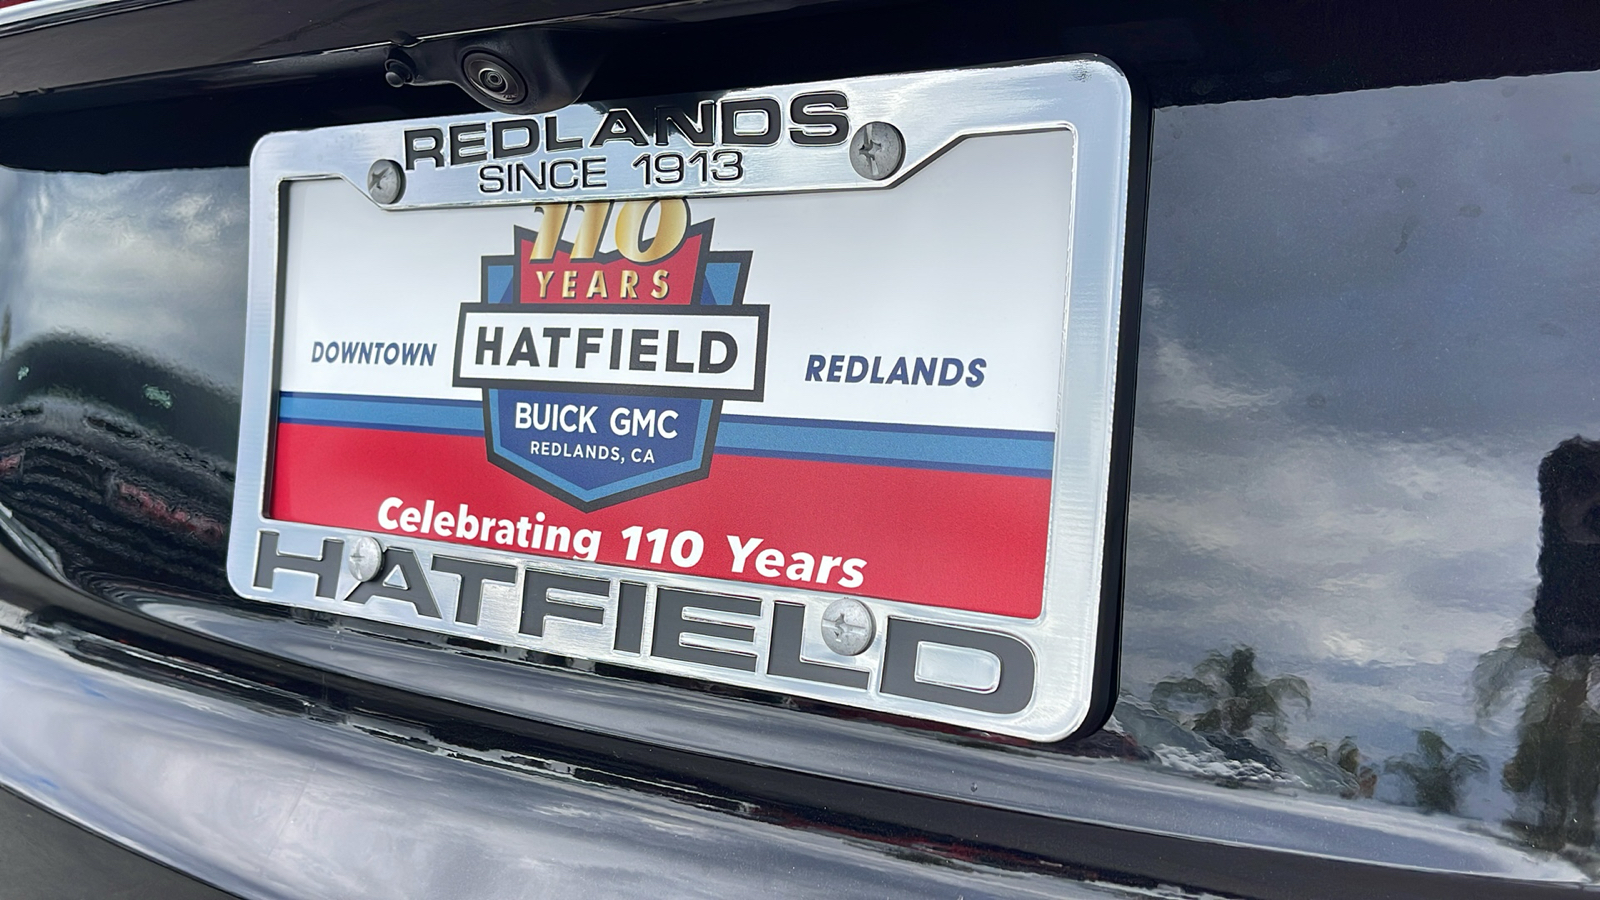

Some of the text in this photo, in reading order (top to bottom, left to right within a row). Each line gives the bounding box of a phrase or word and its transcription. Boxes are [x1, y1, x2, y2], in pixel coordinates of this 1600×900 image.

[404, 91, 850, 170] REDLANDS
[478, 149, 744, 194] SINCE 1913
[530, 199, 690, 264] 110
[536, 268, 670, 301] YEARS
[311, 341, 437, 367] DOWNTOWN
[475, 326, 738, 374] HATFIELD
[805, 354, 988, 388] REDLANDS
[514, 402, 679, 439] BUICK GMC
[530, 440, 656, 464] REDLANDS, CA
[377, 497, 867, 589] Celebrating 110 Years
[253, 530, 1036, 714] HATFIELD
